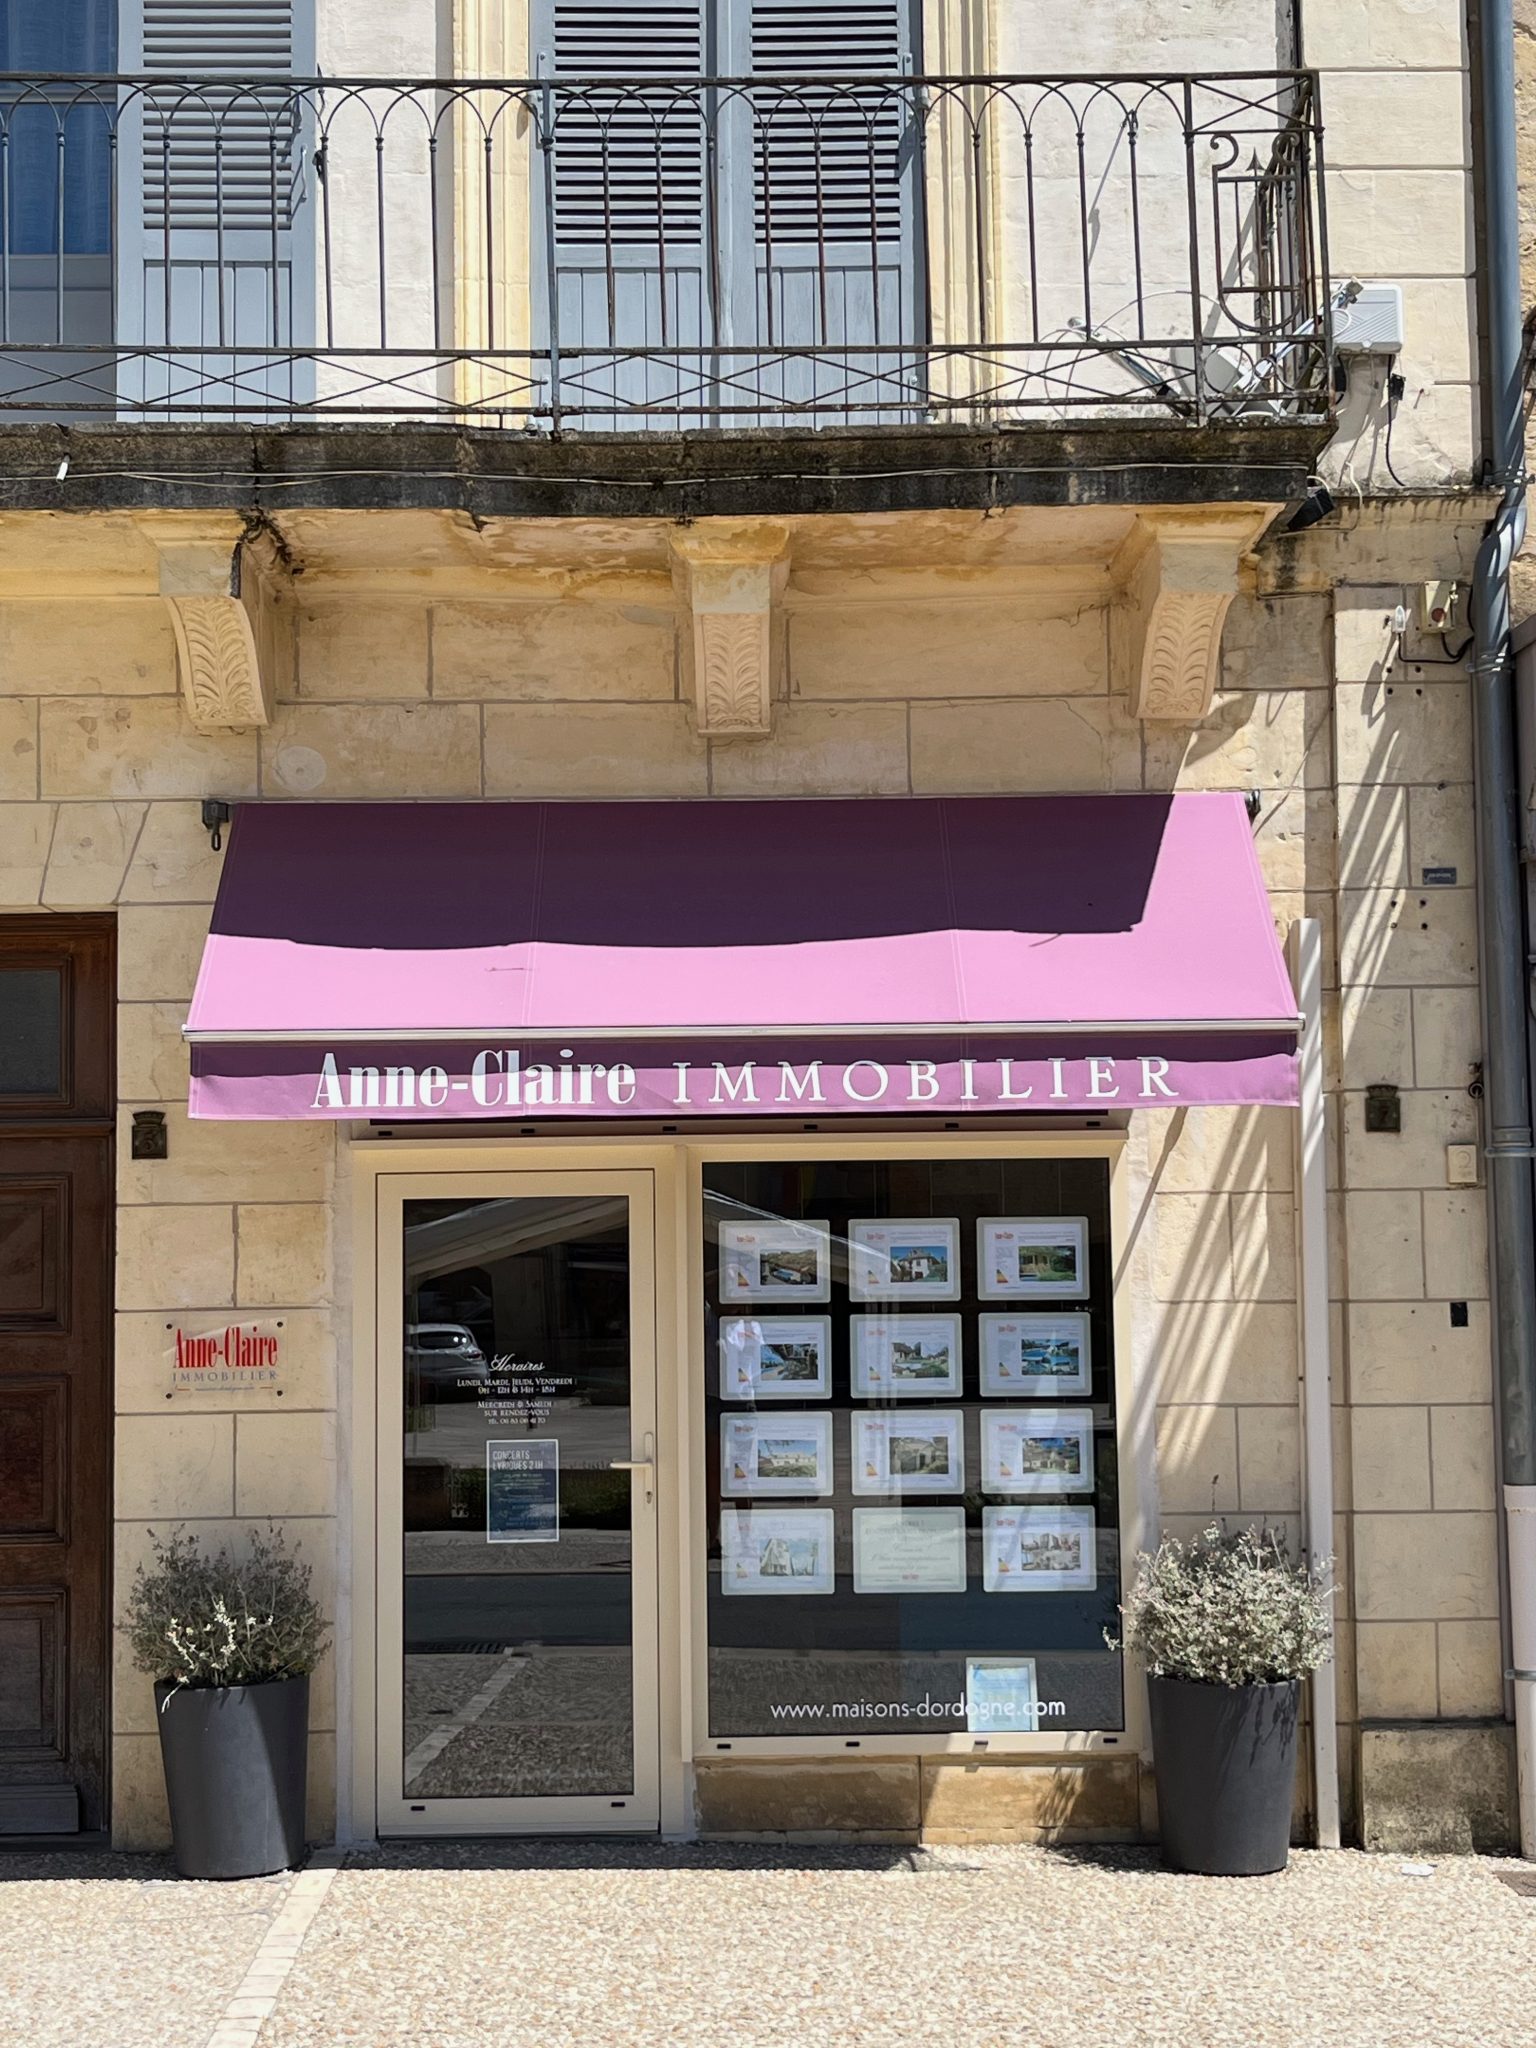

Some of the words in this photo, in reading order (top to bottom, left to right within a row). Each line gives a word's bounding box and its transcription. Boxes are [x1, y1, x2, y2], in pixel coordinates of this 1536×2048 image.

[310, 1048, 636, 1109] Anne-Claire
[673, 1055, 1179, 1103] IMMOBILIER
[173, 1326, 278, 1369] Anne-Claire
[173, 1370, 279, 1382] IMMOBILIER
[488, 1353, 546, 1371] Horaires
[770, 1692, 1066, 1720] www.maisons-dordogne.com
